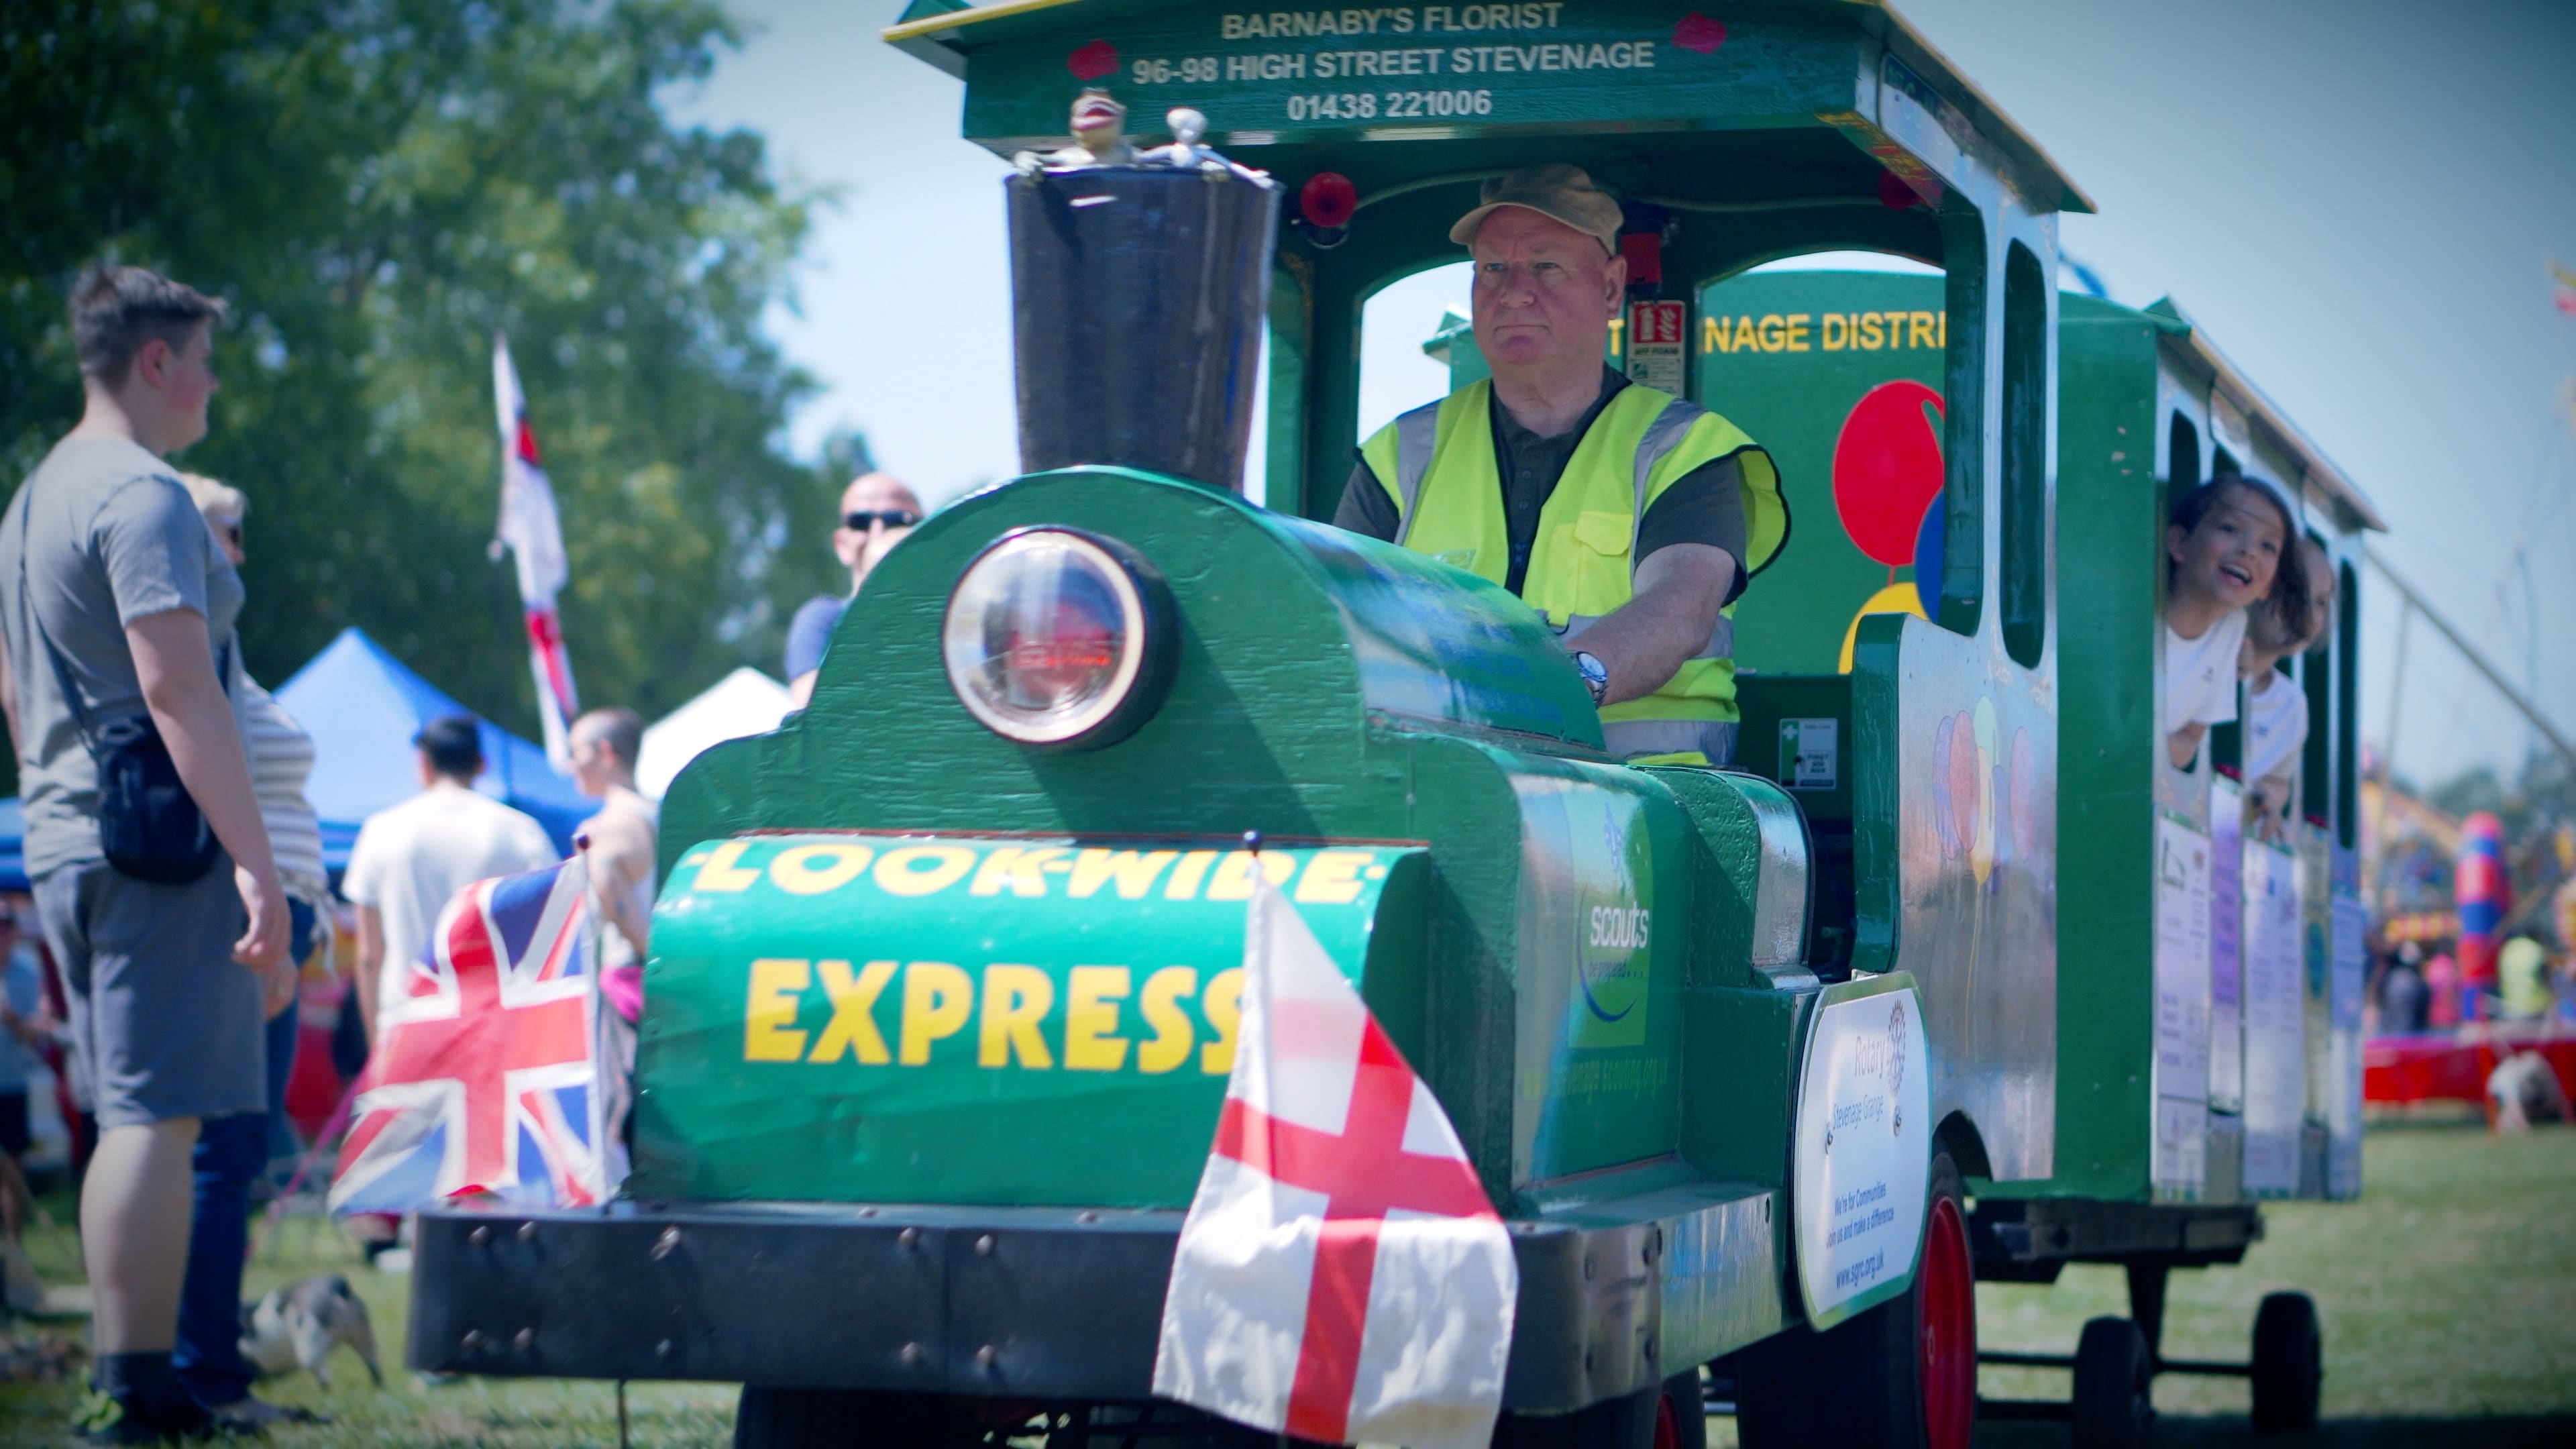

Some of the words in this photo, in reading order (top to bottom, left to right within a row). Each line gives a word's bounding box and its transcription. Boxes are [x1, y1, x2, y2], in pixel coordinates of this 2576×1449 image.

[1221, 7, 1415, 40] BARNABY'S
[1424, 3, 1564, 32] FLORIST
[1132, 57, 1218, 85] 96-98
[1226, 54, 1305, 81] HIGH
[1314, 49, 1444, 78] STREET
[1450, 42, 1655, 74] STEVENAGE
[1287, 93, 1377, 121] 01438
[1385, 90, 1493, 117] 221006
[1704, 314, 1811, 354] NAGE
[1823, 311, 1946, 351] DISTRI
[1590, 901, 1649, 949] scouts
[743, 959, 1250, 1075] EXPRESS
[1854, 1035, 1886, 1079] Rotary
[1832, 1101, 1862, 1130] Stevenage
[1863, 1094, 1884, 1122] Grange
[1837, 1228, 1843, 1244] us
[1843, 1219, 1853, 1241] and
[1854, 1213, 1866, 1236] make
[1871, 1207, 1894, 1229] difference
